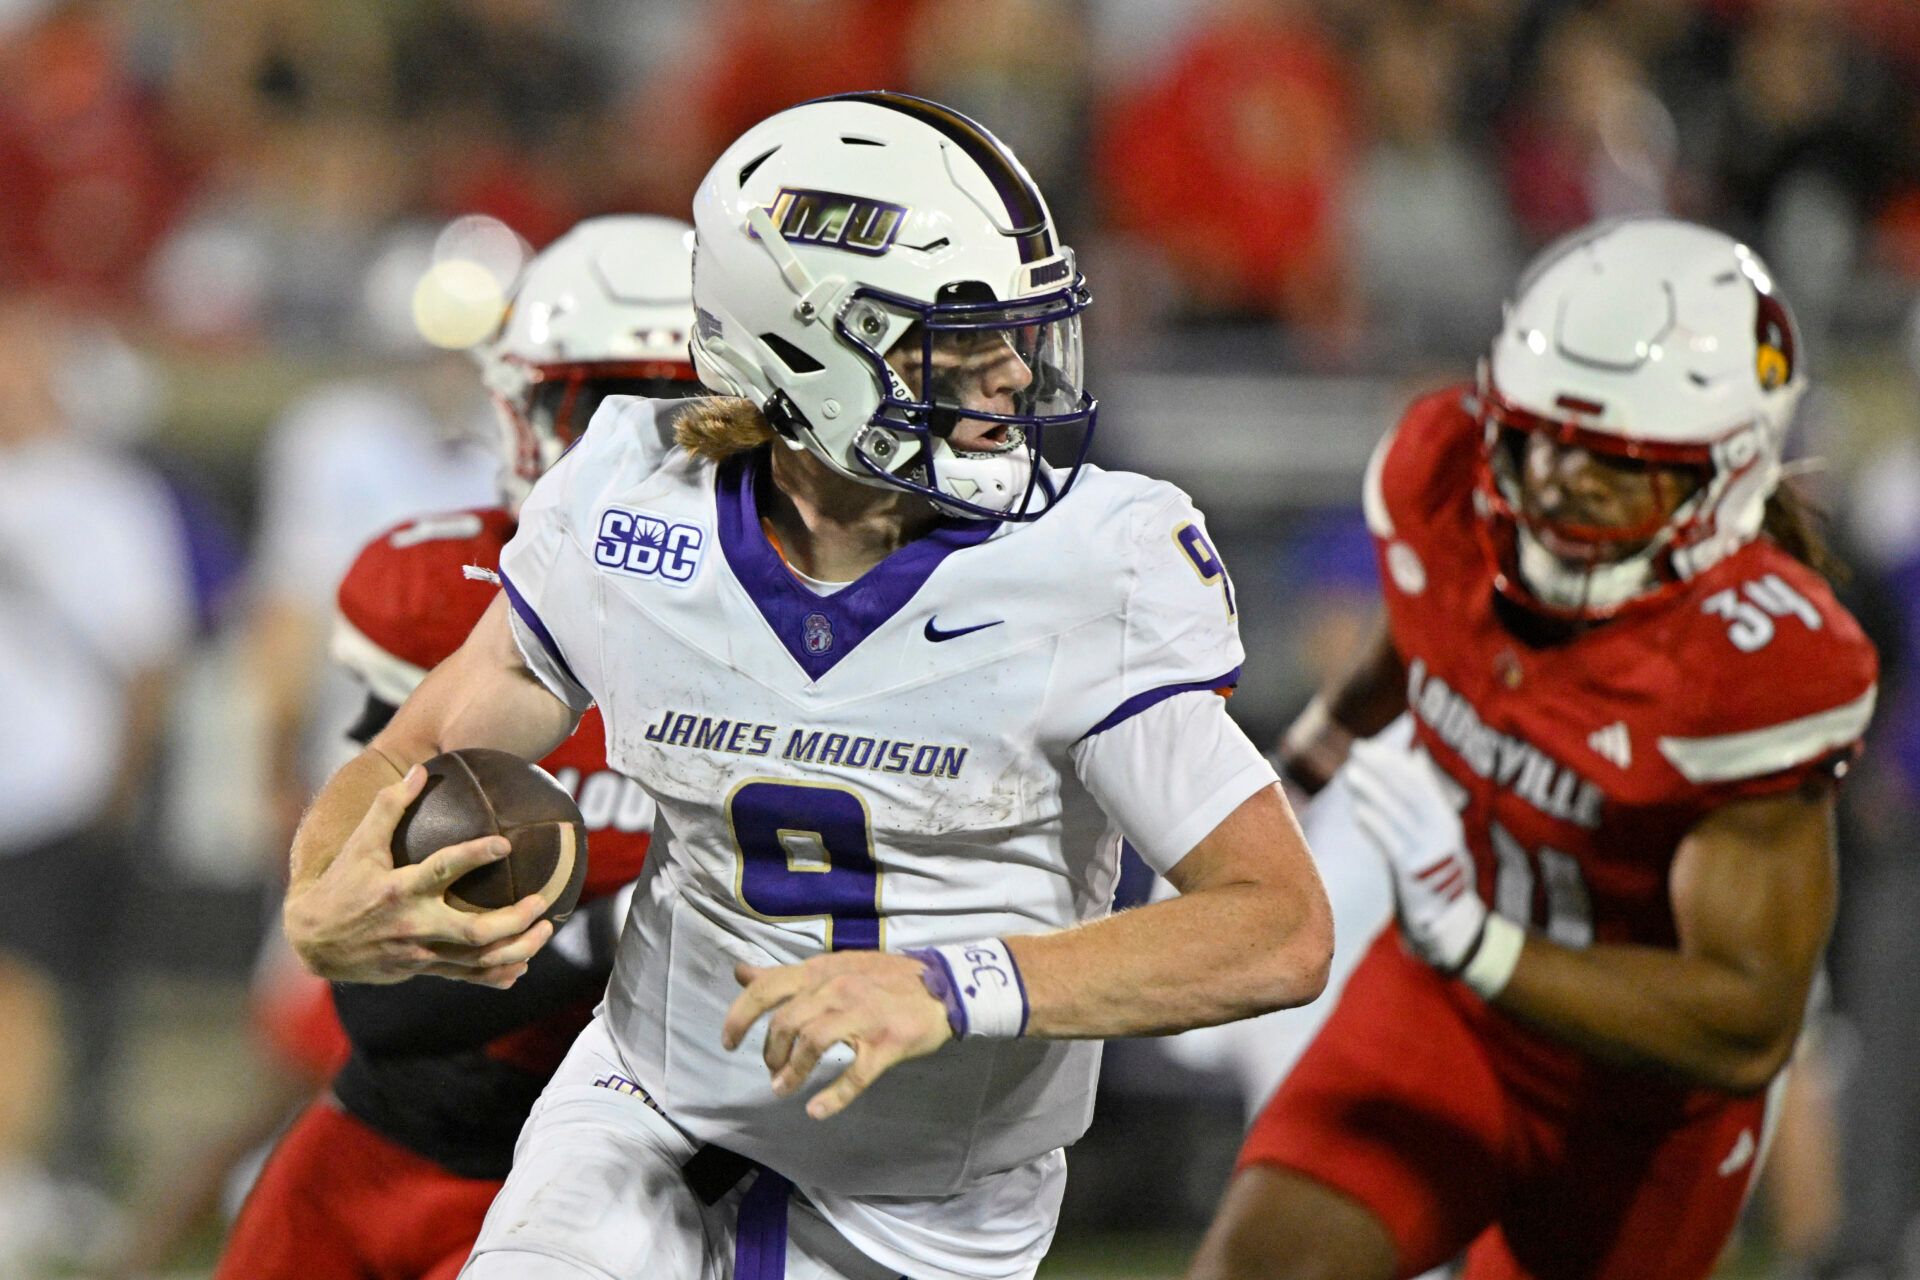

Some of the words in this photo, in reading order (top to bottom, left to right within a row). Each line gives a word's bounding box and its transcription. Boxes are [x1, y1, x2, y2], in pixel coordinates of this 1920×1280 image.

[746, 187, 912, 257] JMU
[594, 509, 703, 582] SBC
[1171, 519, 1237, 624] 9
[1703, 574, 1822, 652] 34
[645, 710, 777, 755] JAMES
[782, 728, 969, 779] MADISON
[1407, 657, 1604, 828] LOUISVILLE
[724, 776, 887, 952] 9
